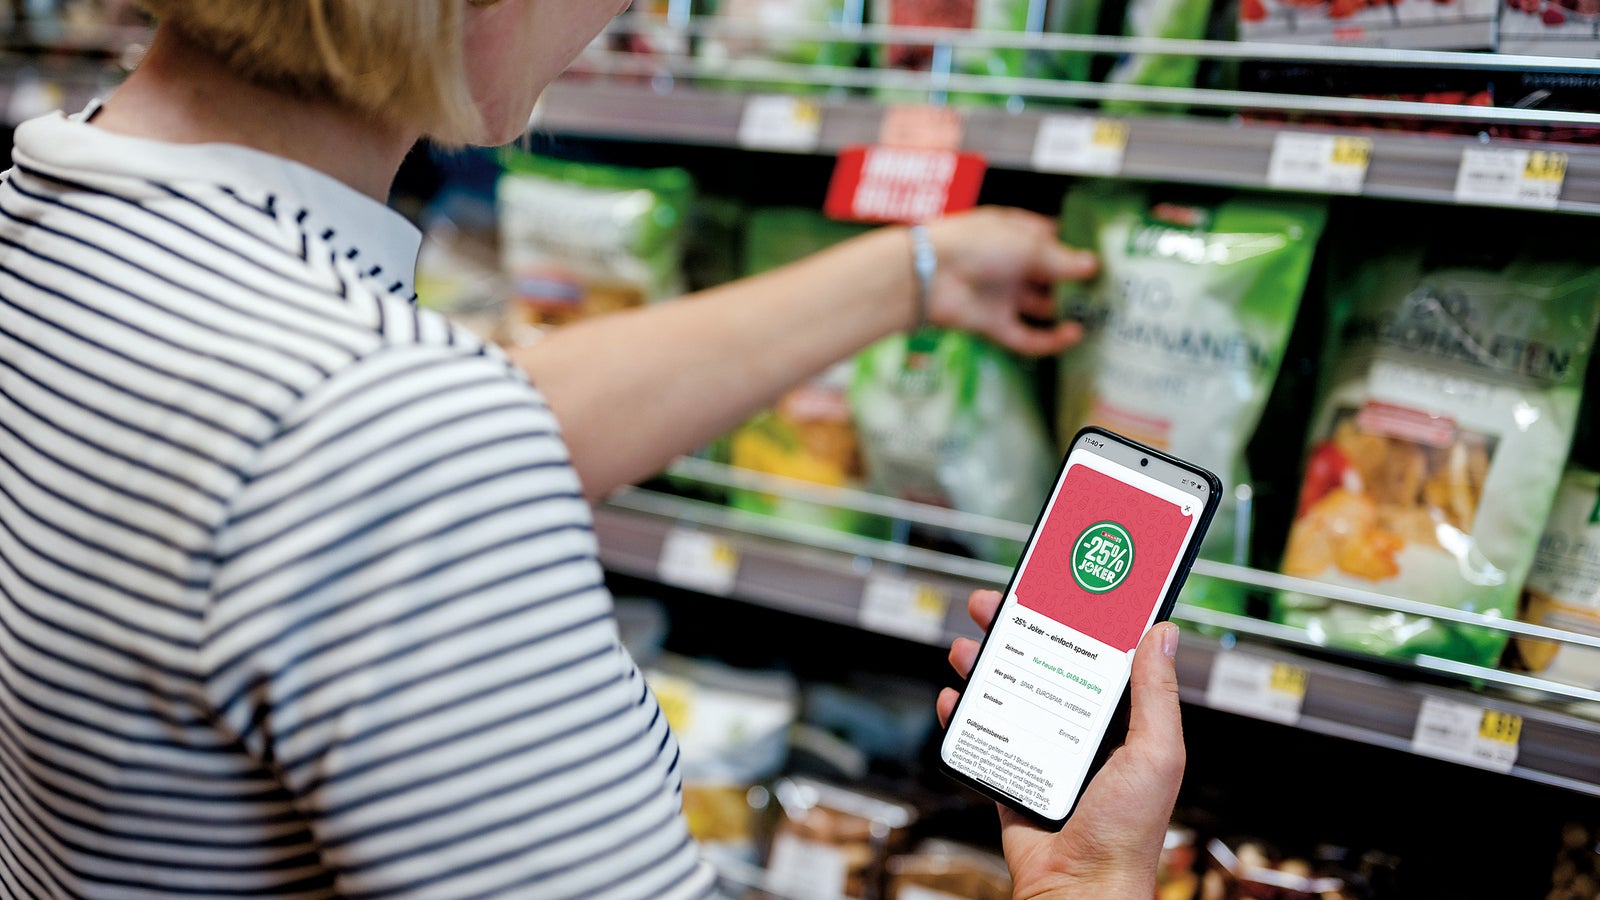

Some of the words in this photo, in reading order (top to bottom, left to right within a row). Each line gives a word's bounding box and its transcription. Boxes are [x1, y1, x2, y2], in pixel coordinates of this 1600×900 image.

[1084, 437, 1099, 447] 11:40
[1083, 536, 1128, 573] -25%
[1078, 558, 1116, 584] JOKER
[1012, 616, 1027, 628] -25%
[1027, 623, 1045, 636] Joker
[1050, 634, 1074, 650] einfach
[1073, 645, 1098, 661] sparen!
[1004, 643, 1025, 657] Zeitraum
[994, 668, 1004, 676] Hier
[1032, 656, 1042, 665] Nur
[1041, 660, 1057, 672] heute
[1020, 680, 1034, 692] SPAR,
[1035, 687, 1063, 706] EUROSPAR,
[1063, 700, 1092, 718] INTERSPAR
[1058, 728, 1080, 745] Einmalig
